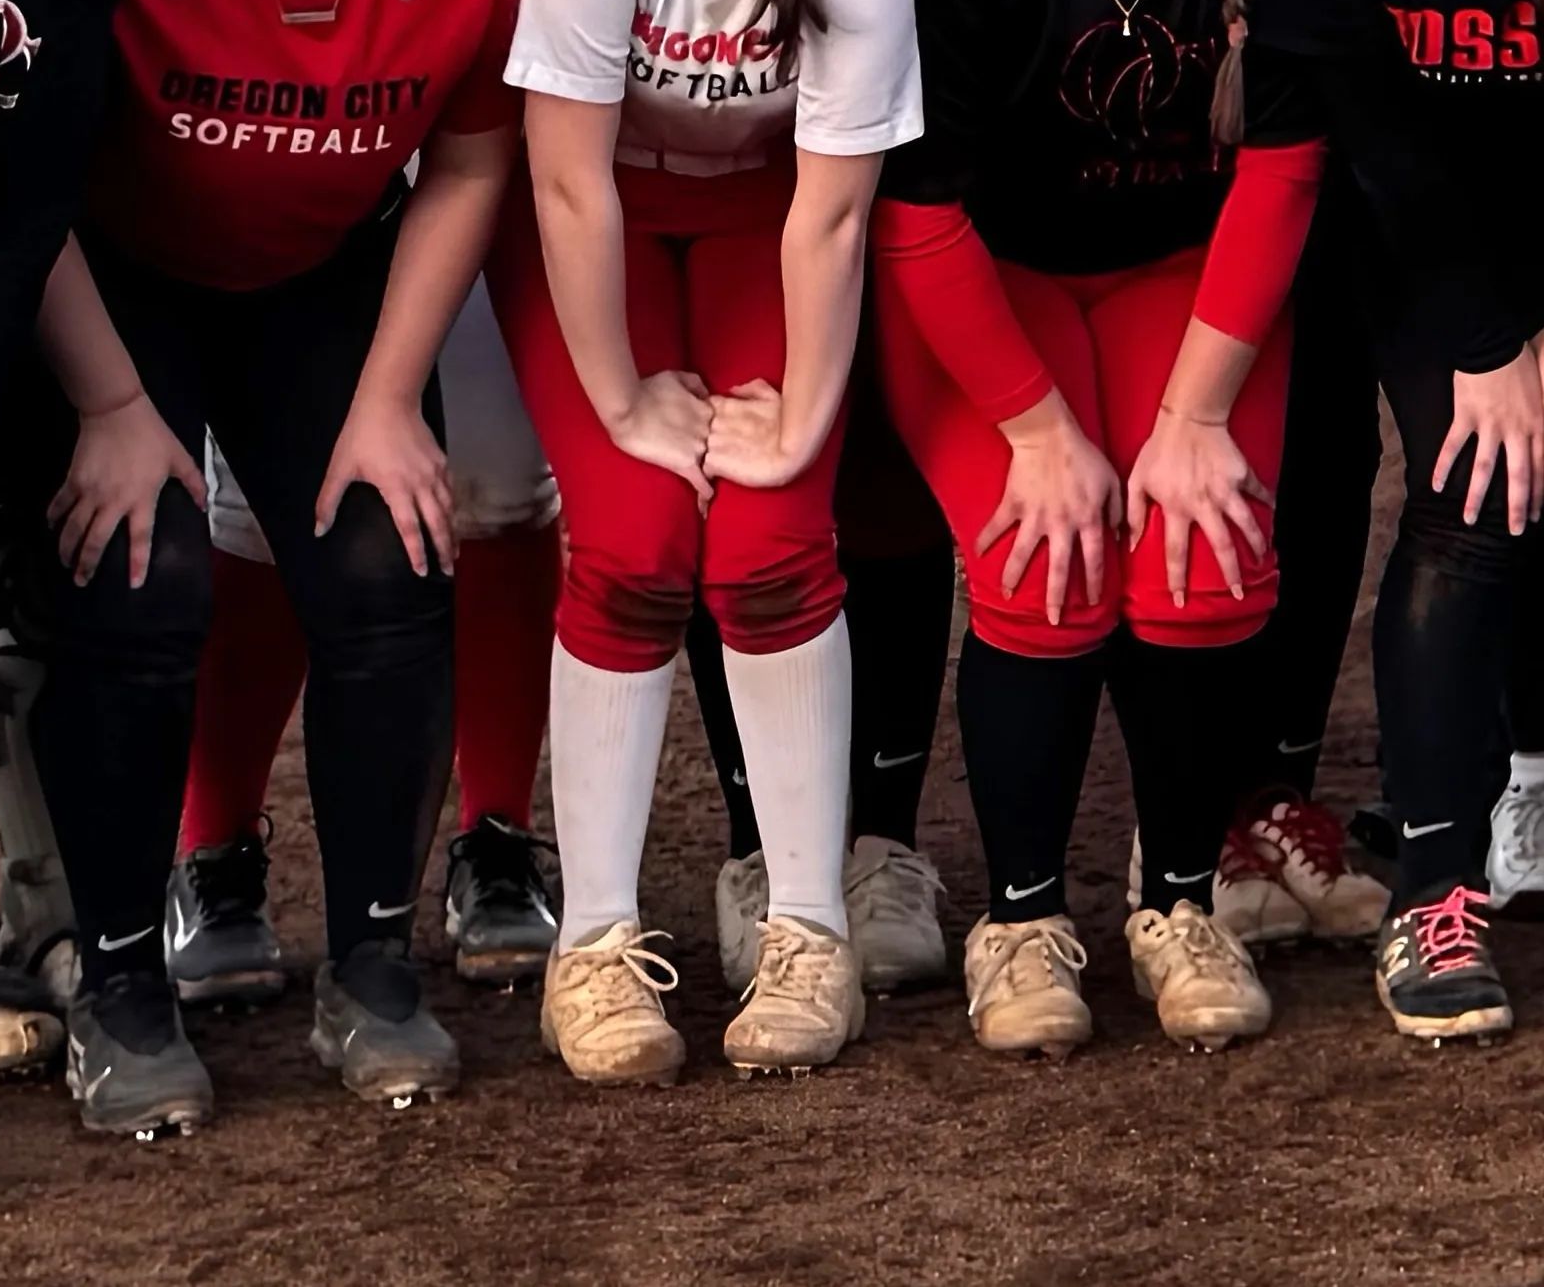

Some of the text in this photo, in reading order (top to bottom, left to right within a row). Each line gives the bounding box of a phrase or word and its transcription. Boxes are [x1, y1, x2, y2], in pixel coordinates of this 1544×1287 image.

[159, 67, 430, 120] OREGON CITY
[168, 112, 392, 154] SOFTBALL
